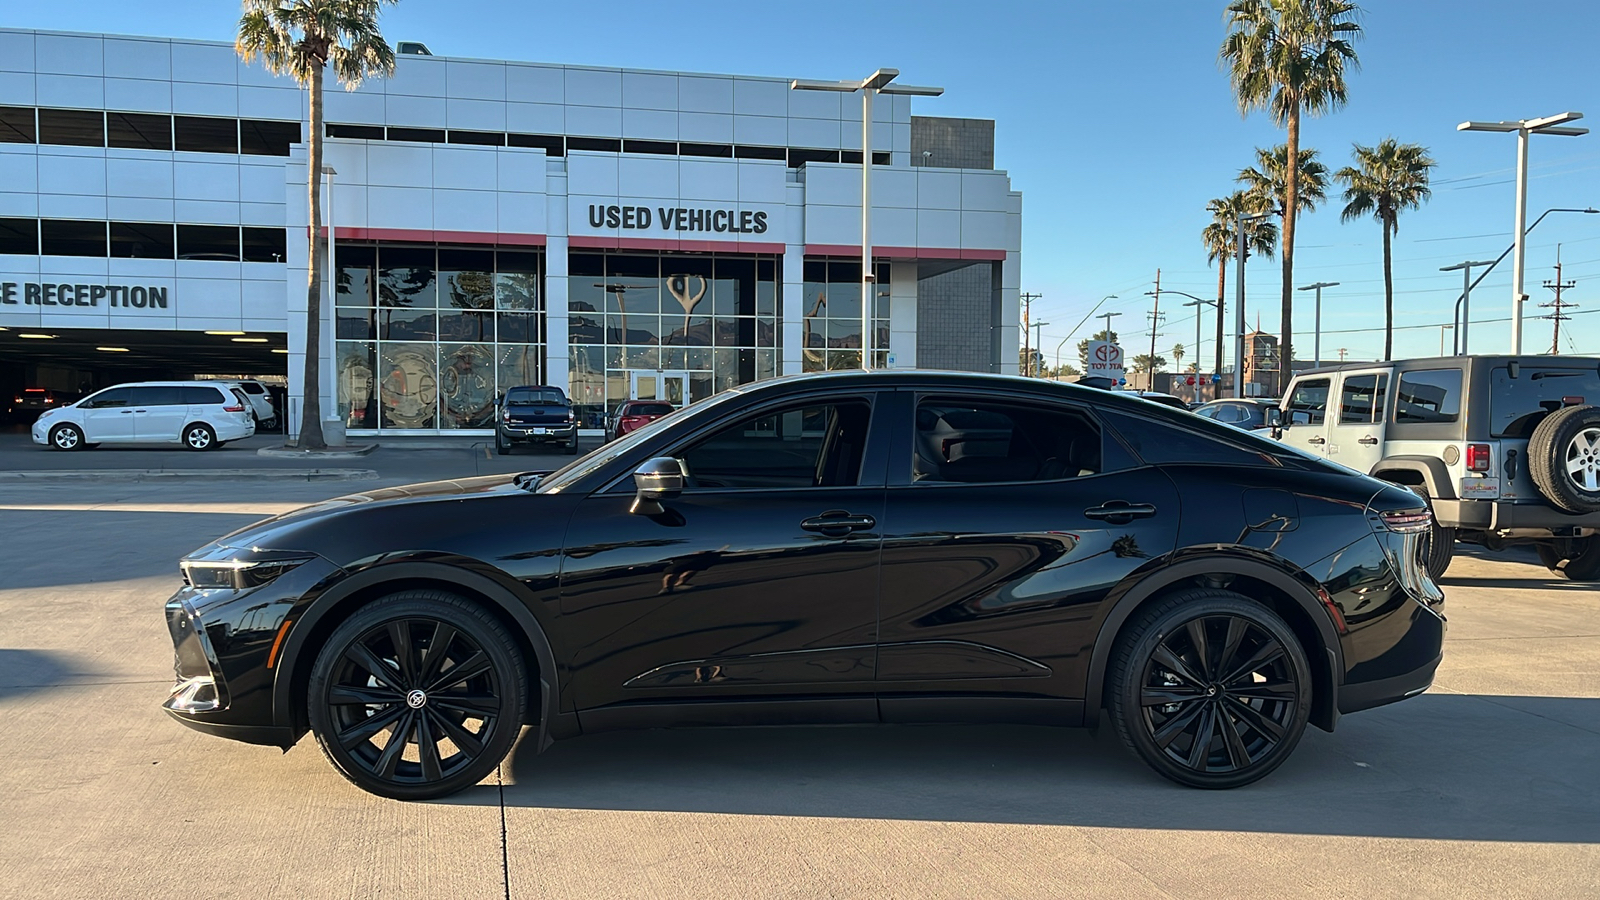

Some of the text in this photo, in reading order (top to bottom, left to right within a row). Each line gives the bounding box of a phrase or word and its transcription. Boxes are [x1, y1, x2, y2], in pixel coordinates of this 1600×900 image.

[589, 204, 768, 234] USED VEHICLES
[0, 282, 168, 309] E RECEPTION
